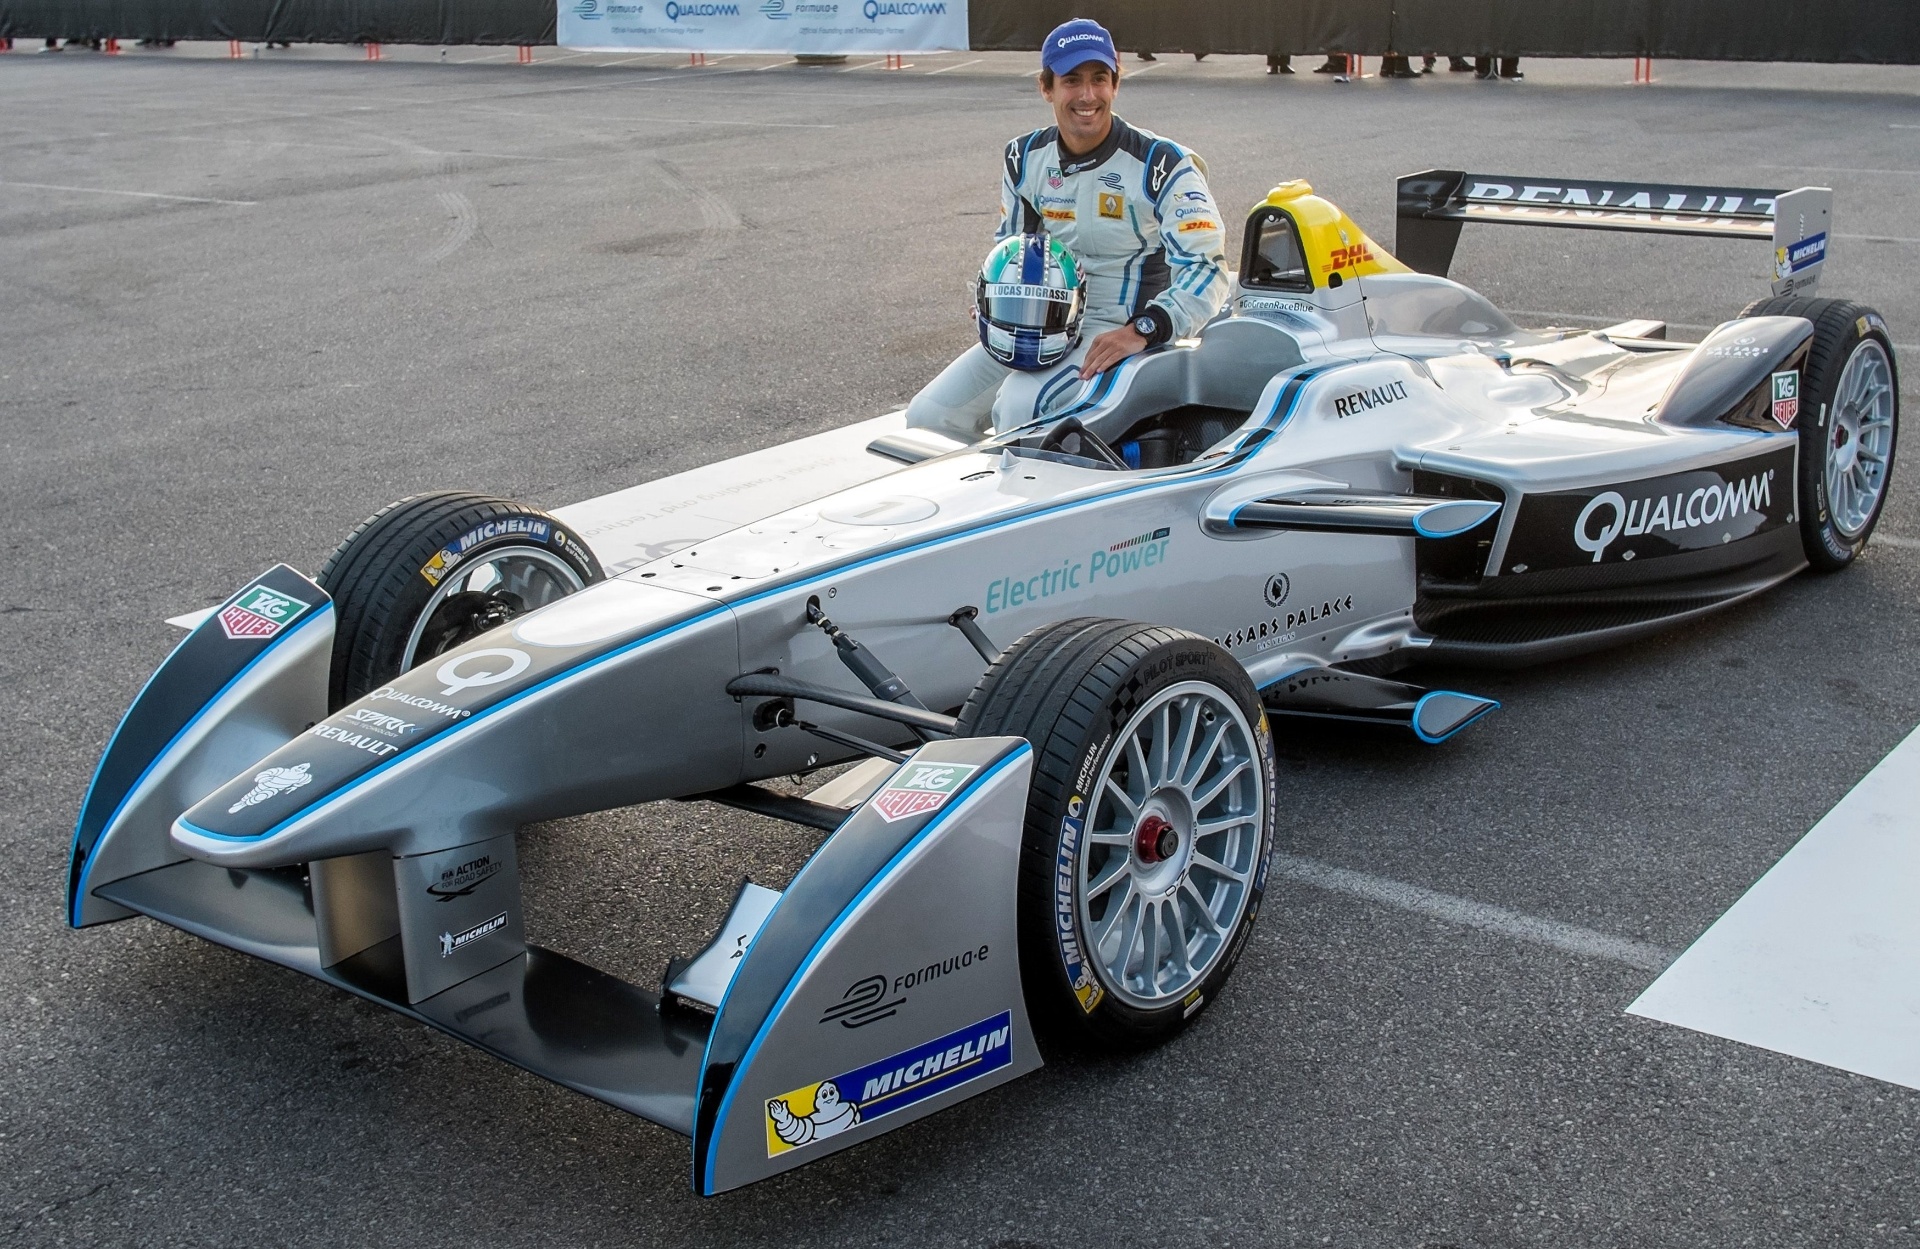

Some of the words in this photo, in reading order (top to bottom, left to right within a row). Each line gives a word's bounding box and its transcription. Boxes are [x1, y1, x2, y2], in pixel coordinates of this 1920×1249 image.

[666, 1, 739, 23] QUALCOMM
[863, 0, 946, 23] QUALCOMM
[1046, 211, 1071, 219] DHL
[1185, 221, 1211, 230] DHL
[1328, 243, 1377, 271] DHL
[993, 285, 1022, 296] LUCAS
[1024, 286, 1069, 301] DIGRASSI
[1240, 300, 1314, 312] #GoGreenRaceBlue
[1334, 381, 1409, 419] RENAULT
[1777, 376, 1795, 399] TAG
[1774, 401, 1796, 424] HEUER
[460, 519, 547, 551] MICHELIN
[985, 559, 1082, 614] Electric
[1089, 538, 1170, 584] Power
[247, 592, 290, 618] TAG
[1287, 594, 1352, 630] PALACE
[225, 608, 276, 634] HEUER
[436, 648, 531, 697] Q
[1143, 655, 1174, 685] PILOT
[1175, 650, 1207, 667] SPORT
[345, 708, 416, 735] SPARK
[311, 724, 399, 756] RENAULT
[1075, 742, 1098, 792] MICHELIN
[1082, 776, 1093, 796] Total
[1089, 733, 1111, 777] Performance
[904, 767, 955, 790] TAG
[879, 791, 942, 817] HEUER
[441, 871, 454, 880] FIA
[456, 855, 490, 877] ACTION
[454, 872, 476, 886] ROAD
[476, 860, 503, 878] SAFETY
[1058, 822, 1081, 965] MICHELIN
[455, 915, 505, 946] MICHELIN
[861, 1025, 1009, 1101] MICHELIN
